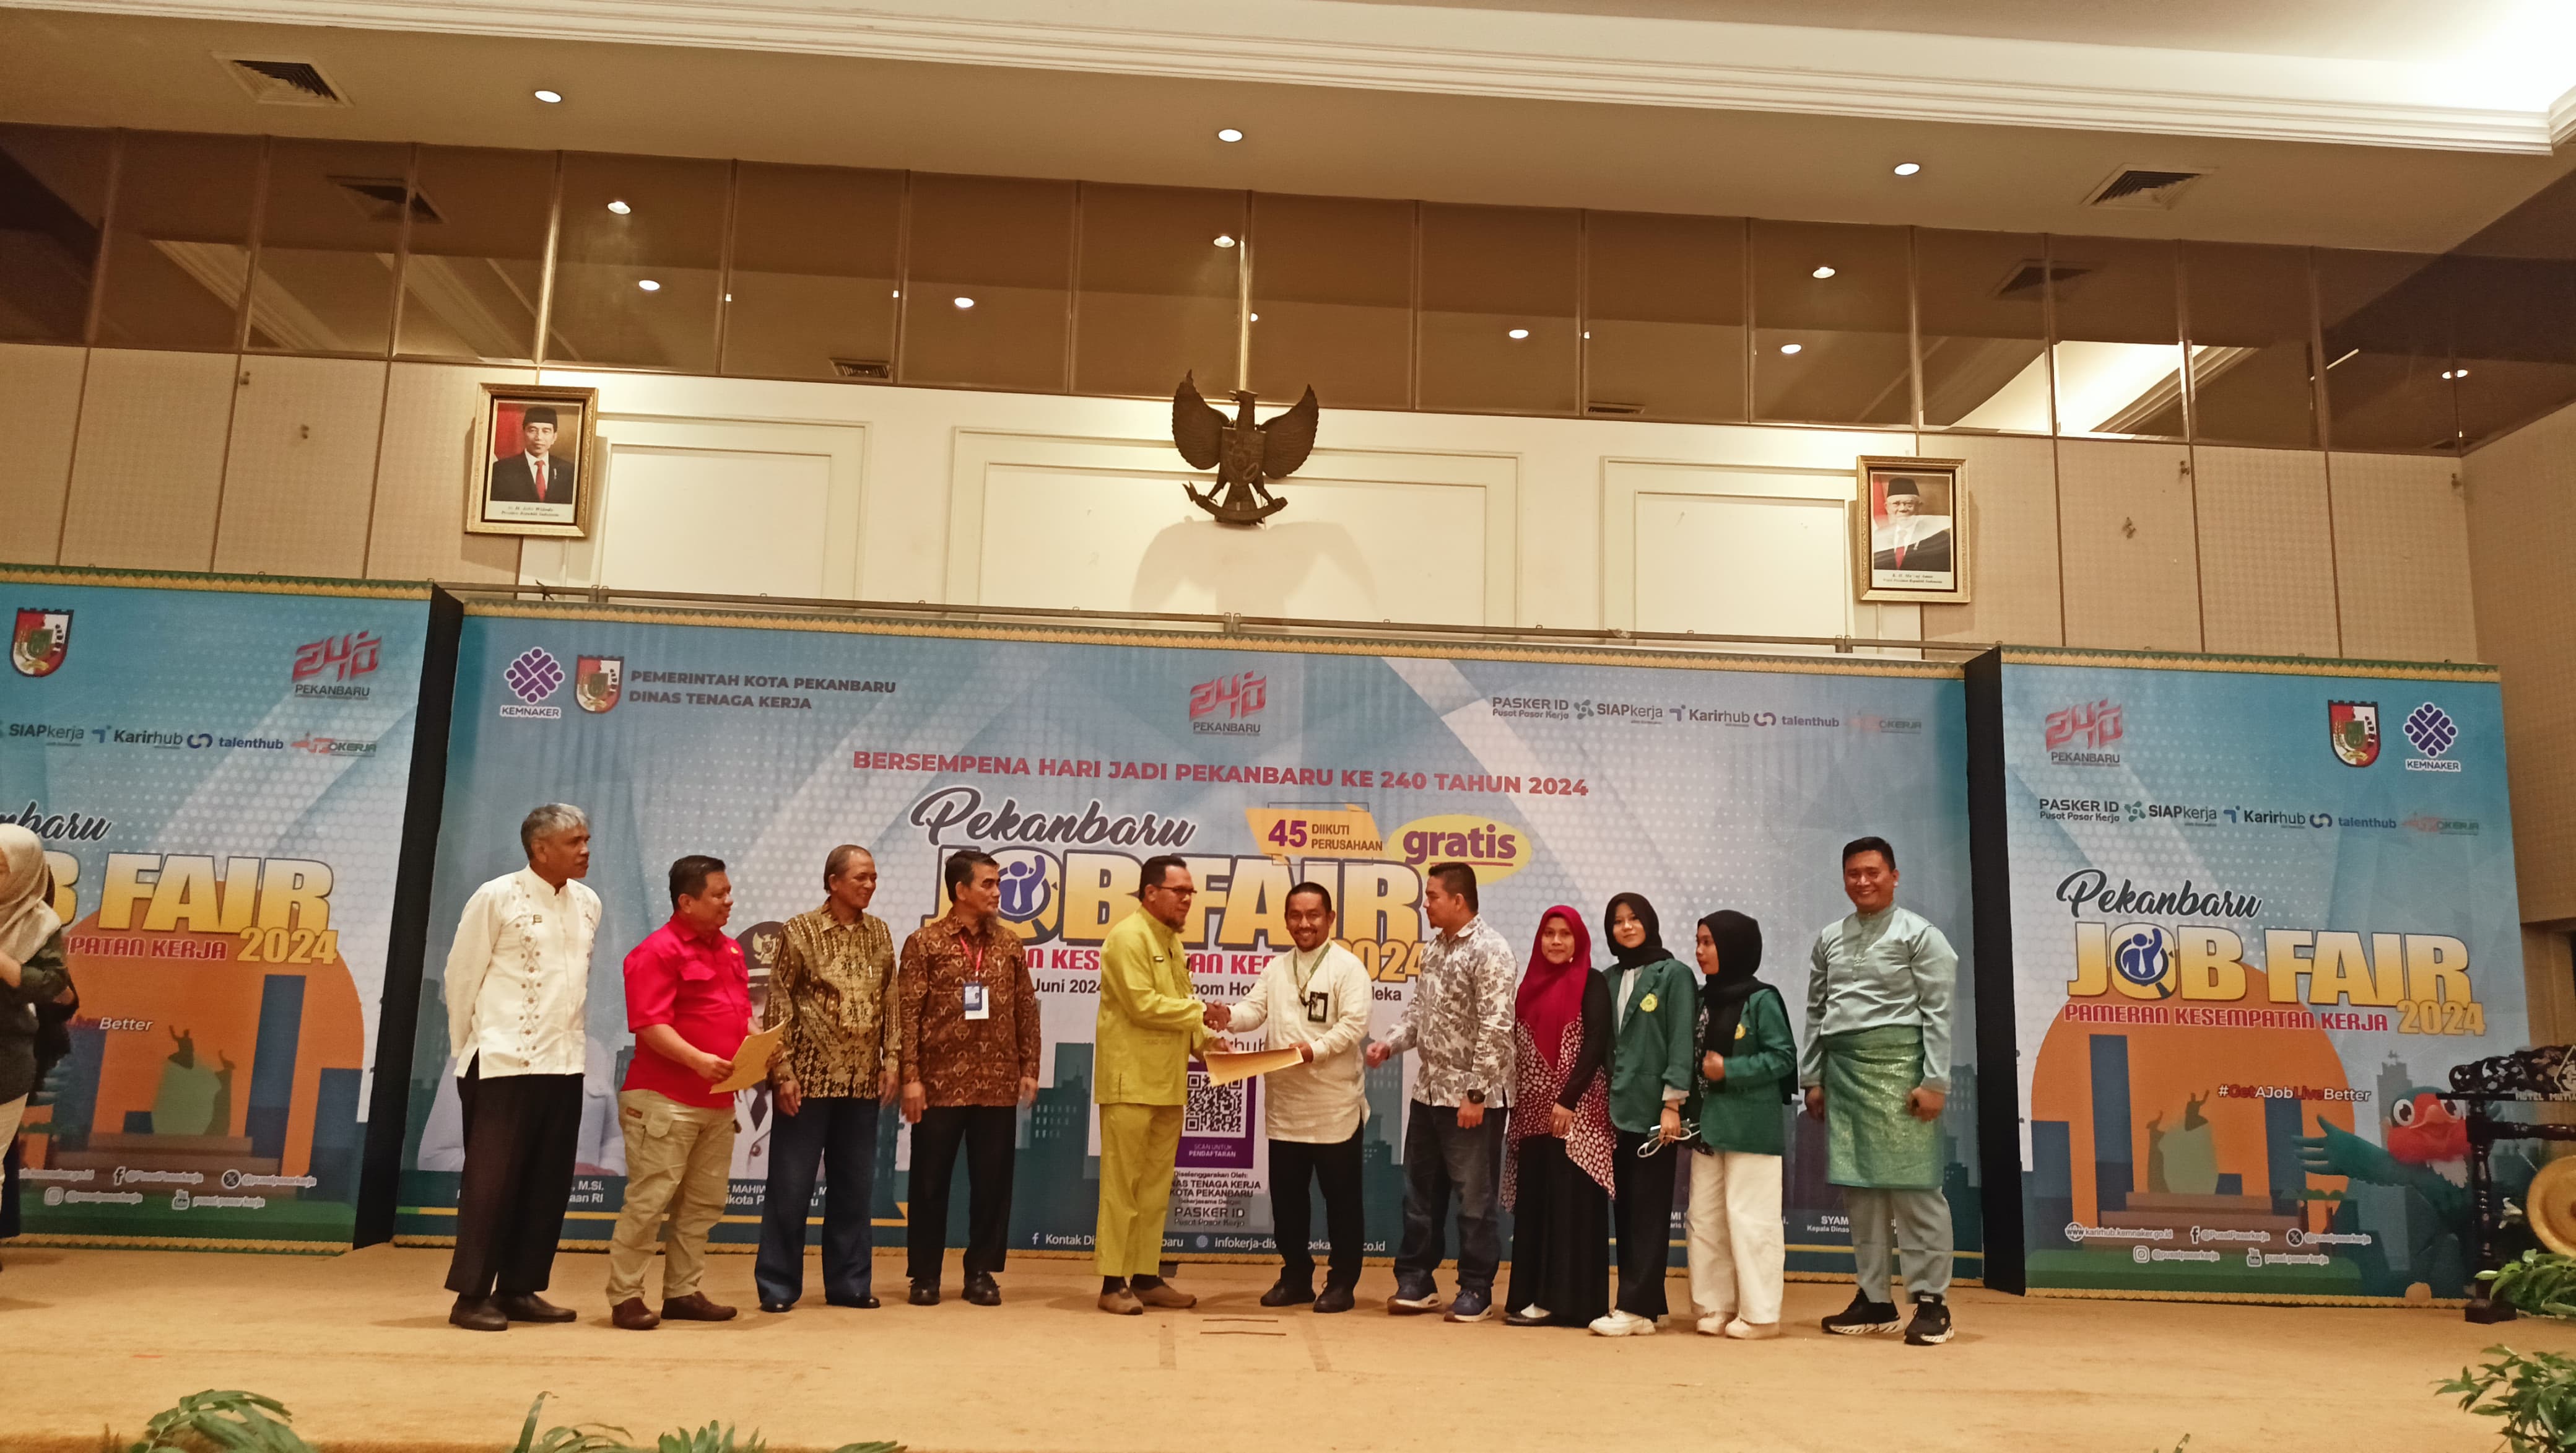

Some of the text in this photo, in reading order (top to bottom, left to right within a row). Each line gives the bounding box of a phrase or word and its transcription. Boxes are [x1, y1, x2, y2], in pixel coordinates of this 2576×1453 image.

[631, 670, 896, 693] PEMERINTAH KOTA PEKANBARU
[295, 684, 370, 697] PEKANBARU
[629, 690, 812, 709] DINAS TENAGA KERJA
[1492, 697, 1569, 710] PASKER ID
[502, 706, 560, 717] KEMNAKER
[1596, 703, 1663, 720] SIAPkerja
[1689, 709, 1751, 723] Karirhub
[1193, 722, 1261, 733] PEKANBARU
[1782, 715, 1840, 728] talenthub
[9, 723, 84, 741] SIAPkerja
[114, 730, 183, 745] Karirhub
[219, 737, 284, 750] talenthub
[2051, 752, 2120, 763] PEKANBARU
[2407, 761, 2460, 770] KEMNAKER
[853, 751, 1589, 796] BERSEMPENA HARI JADI PEKANBARU KE 240 TAHUN 2024
[2040, 798, 2119, 812] PASKER ID
[910, 787, 1196, 847] Pekanbaru
[2149, 805, 2217, 822] SIAPkerja
[2244, 810, 2305, 825] Karirhub
[2338, 816, 2396, 829] talenthub
[1268, 819, 1307, 847] 45
[1312, 824, 1350, 836] DIIKUTI
[1311, 839, 1383, 852] PERUSAHAAN
[1402, 824, 1517, 865] gratis
[98, 852, 334, 935] FAIR
[2056, 869, 2262, 918] Pekanbaru
[150, 938, 227, 960] KERJA
[237, 927, 339, 964] 2024
[2067, 921, 2472, 1008] JOB FAIR
[1034, 978, 1065, 993] Juni
[2065, 999, 2487, 1036] PAMERAN KESEMPATAN KERJA 2024
[1190, 1180, 1229, 1189] TENAGA
[1230, 1181, 1261, 1190] KERJA
[1170, 1189, 1253, 1198] KOTA PEKANBARU
[1175, 1208, 1245, 1217] PASKER ID
[1045, 1234, 1082, 1245] Kontak
